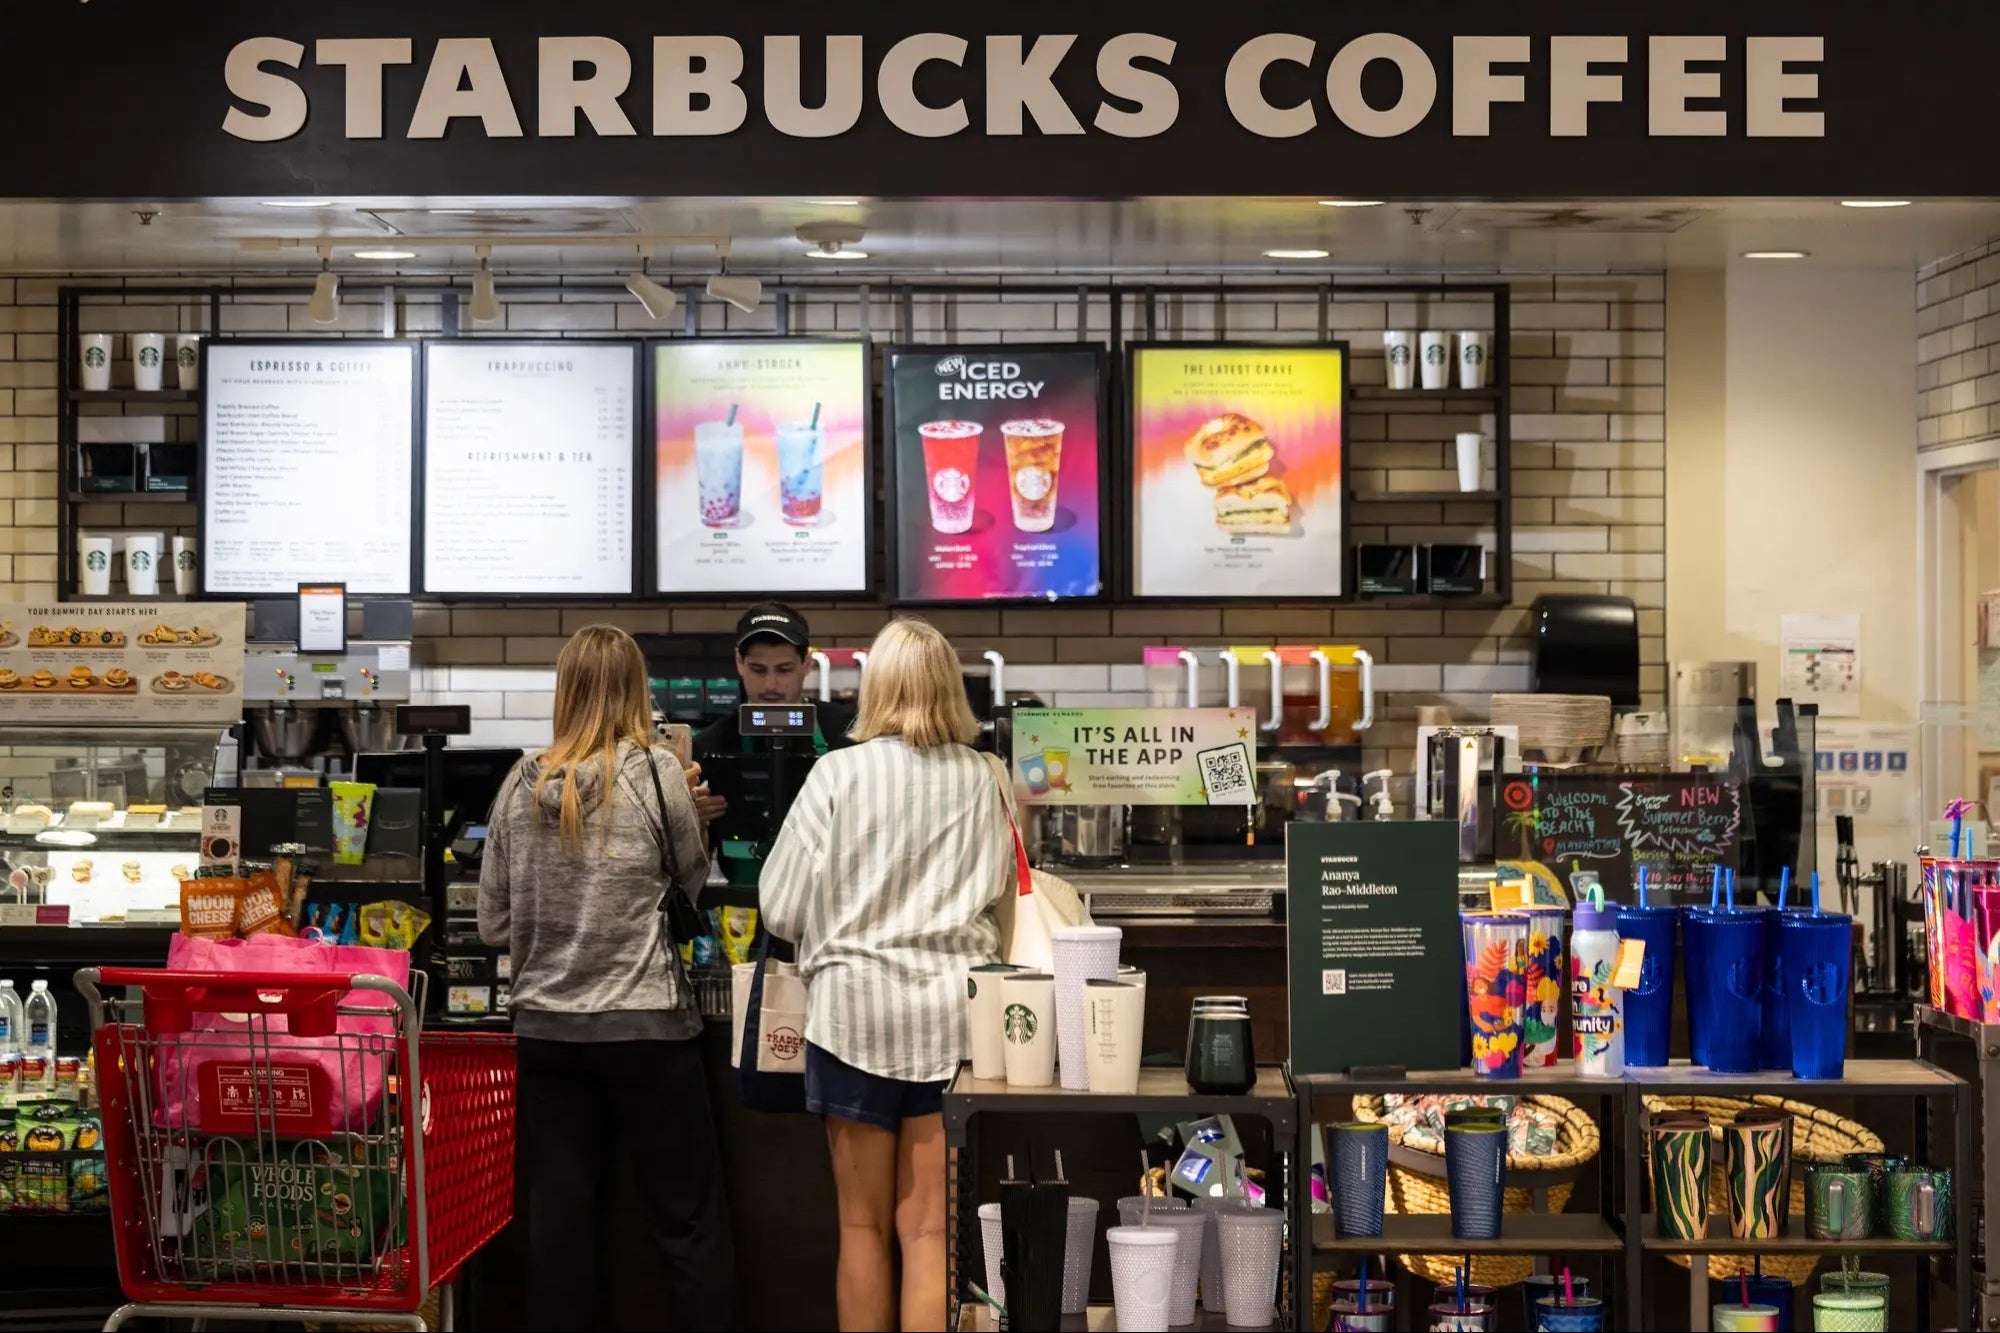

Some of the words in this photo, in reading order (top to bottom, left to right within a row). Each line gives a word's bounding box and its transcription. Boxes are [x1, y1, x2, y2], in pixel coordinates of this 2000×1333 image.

[222, 32, 1180, 142] STARBUCKS
[1224, 32, 1825, 139] COFFEE
[250, 360, 310, 372] ESPRESSO
[937, 356, 964, 374] NEW
[960, 362, 1021, 380] ICED
[1184, 364, 1204, 375] THE
[1210, 364, 1251, 375] LATEST
[1256, 364, 1293, 375] CRAVE
[939, 381, 1045, 400] ENERGY
[468, 452, 552, 462] REFRESHMENT
[572, 451, 593, 462] TEA
[28, 607, 49, 616] YOUR
[51, 607, 85, 616] SUMMER
[88, 607, 103, 616] DAY
[106, 607, 136, 616] STARTS
[139, 607, 158, 616] HERE
[751, 614, 790, 625] STARBUCKS
[1073, 725, 1116, 744] IT'S
[1123, 725, 1163, 744] ALL
[1171, 725, 1195, 743] IN
[1085, 748, 1129, 766] THE
[1136, 748, 1183, 766] APP
[1681, 785, 1720, 807] NEW
[1697, 808, 1734, 829] Berry
[1555, 838, 1621, 852] MANHATTAN
[1320, 856, 1359, 864] STARBUCKS
[1632, 848, 1670, 861] Barista
[1321, 869, 1360, 882] Ananya
[1321, 884, 1398, 896] Rao-Middleton
[187, 894, 235, 911] MOON
[188, 910, 235, 925] CHEESE
[766, 1033, 806, 1047] TRADER
[770, 1043, 800, 1054] JOE'S
[250, 1069, 285, 1077] ARING
[251, 1165, 316, 1186] WHOLE
[252, 1182, 314, 1202] FOODS
[259, 1201, 303, 1211] MAKET
